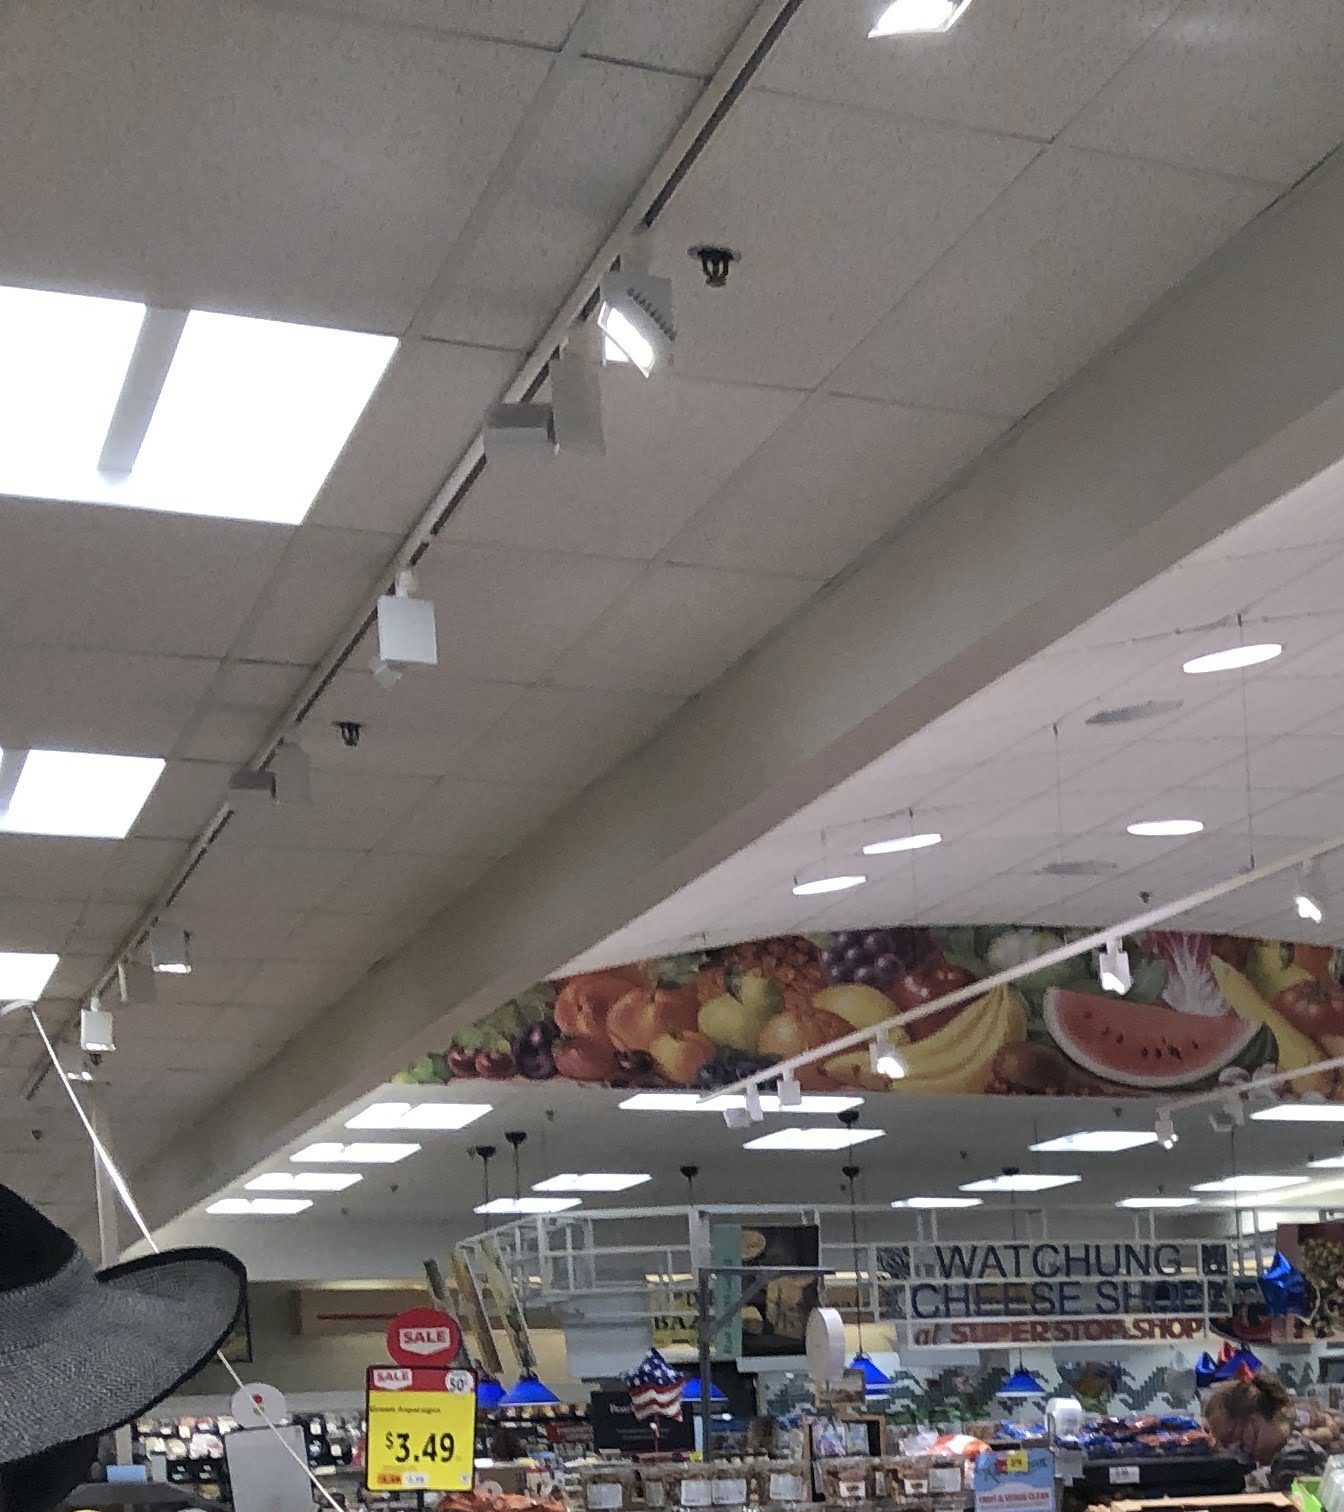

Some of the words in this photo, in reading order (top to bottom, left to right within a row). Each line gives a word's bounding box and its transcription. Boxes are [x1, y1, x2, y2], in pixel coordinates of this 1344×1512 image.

[935, 1243, 1182, 1279] WATCHUNG
[911, 1280, 1082, 1319] CHEESE
[403, 1330, 447, 1344] SALE
[385, 1430, 455, 1463] $3.49
